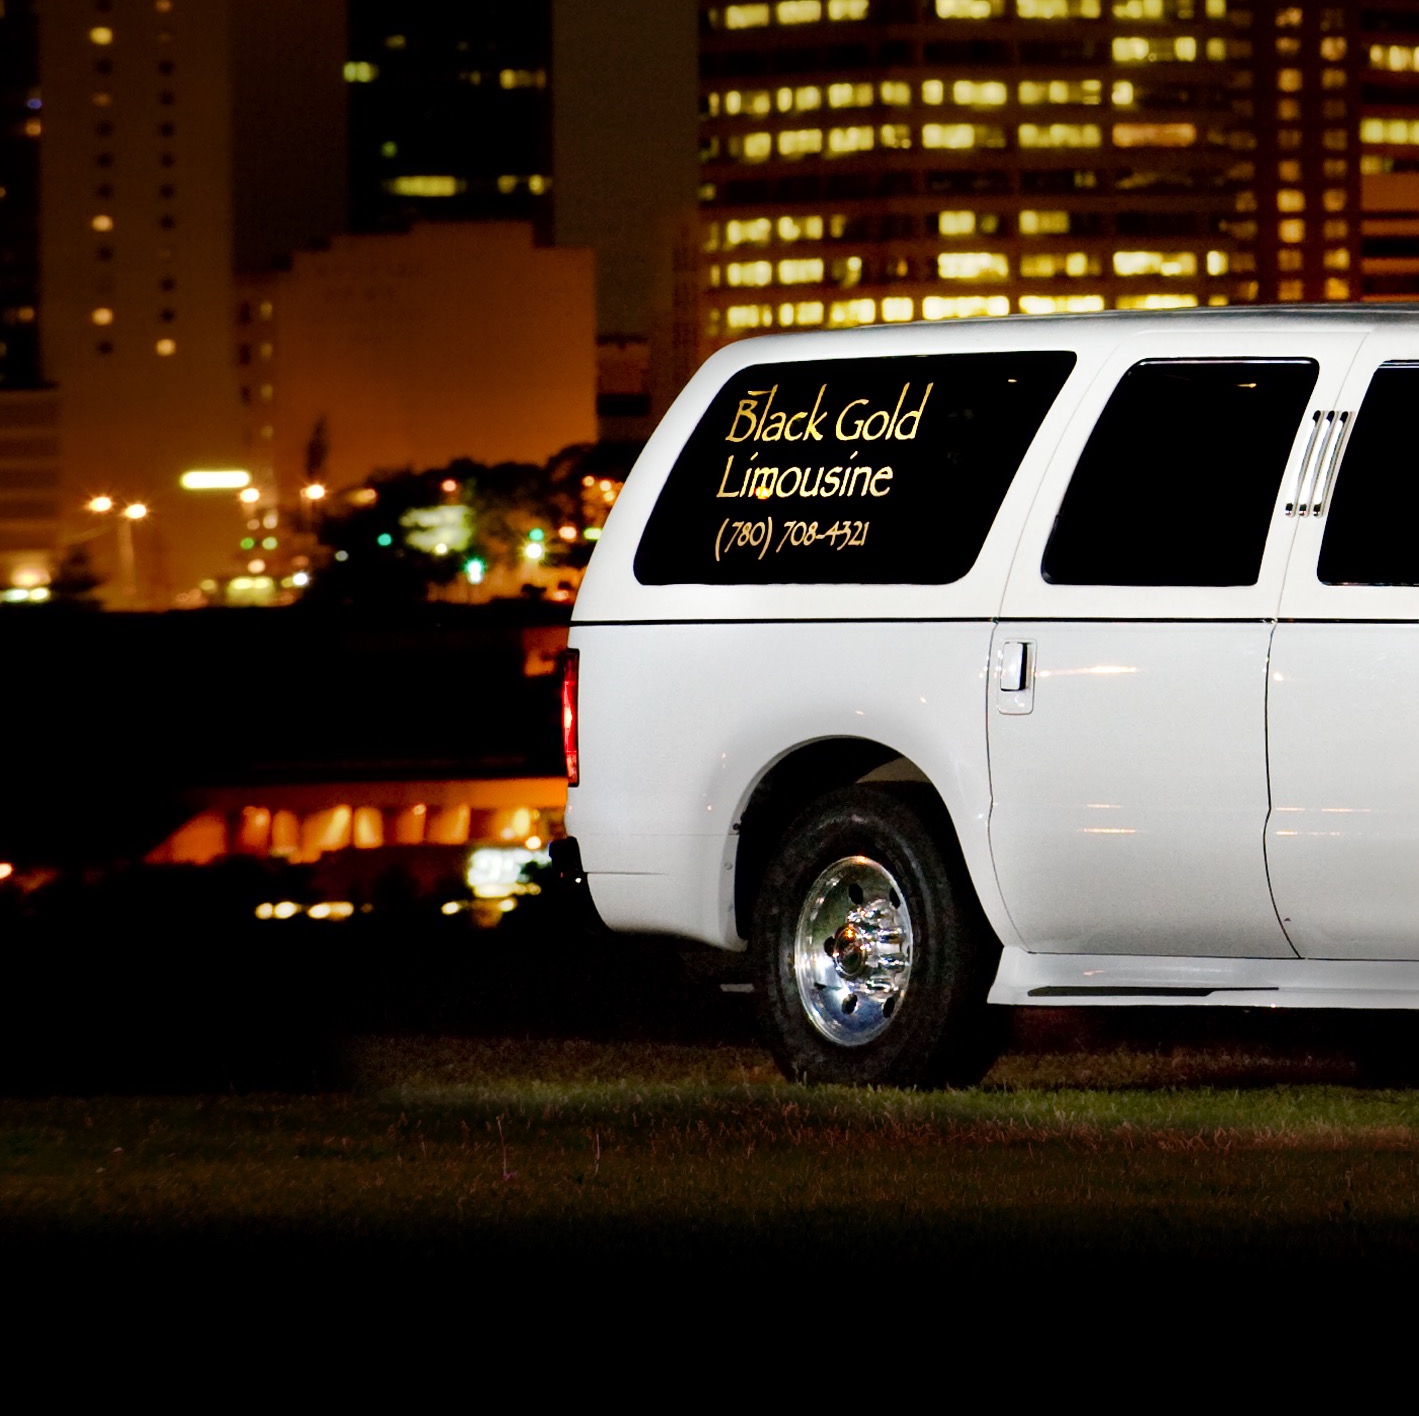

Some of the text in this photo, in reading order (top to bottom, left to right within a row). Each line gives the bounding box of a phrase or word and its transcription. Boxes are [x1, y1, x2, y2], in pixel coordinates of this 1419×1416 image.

[724, 381, 934, 443] Black Gold
[716, 450, 894, 501] Limousine
[714, 516, 871, 562] (780) 708-4321
